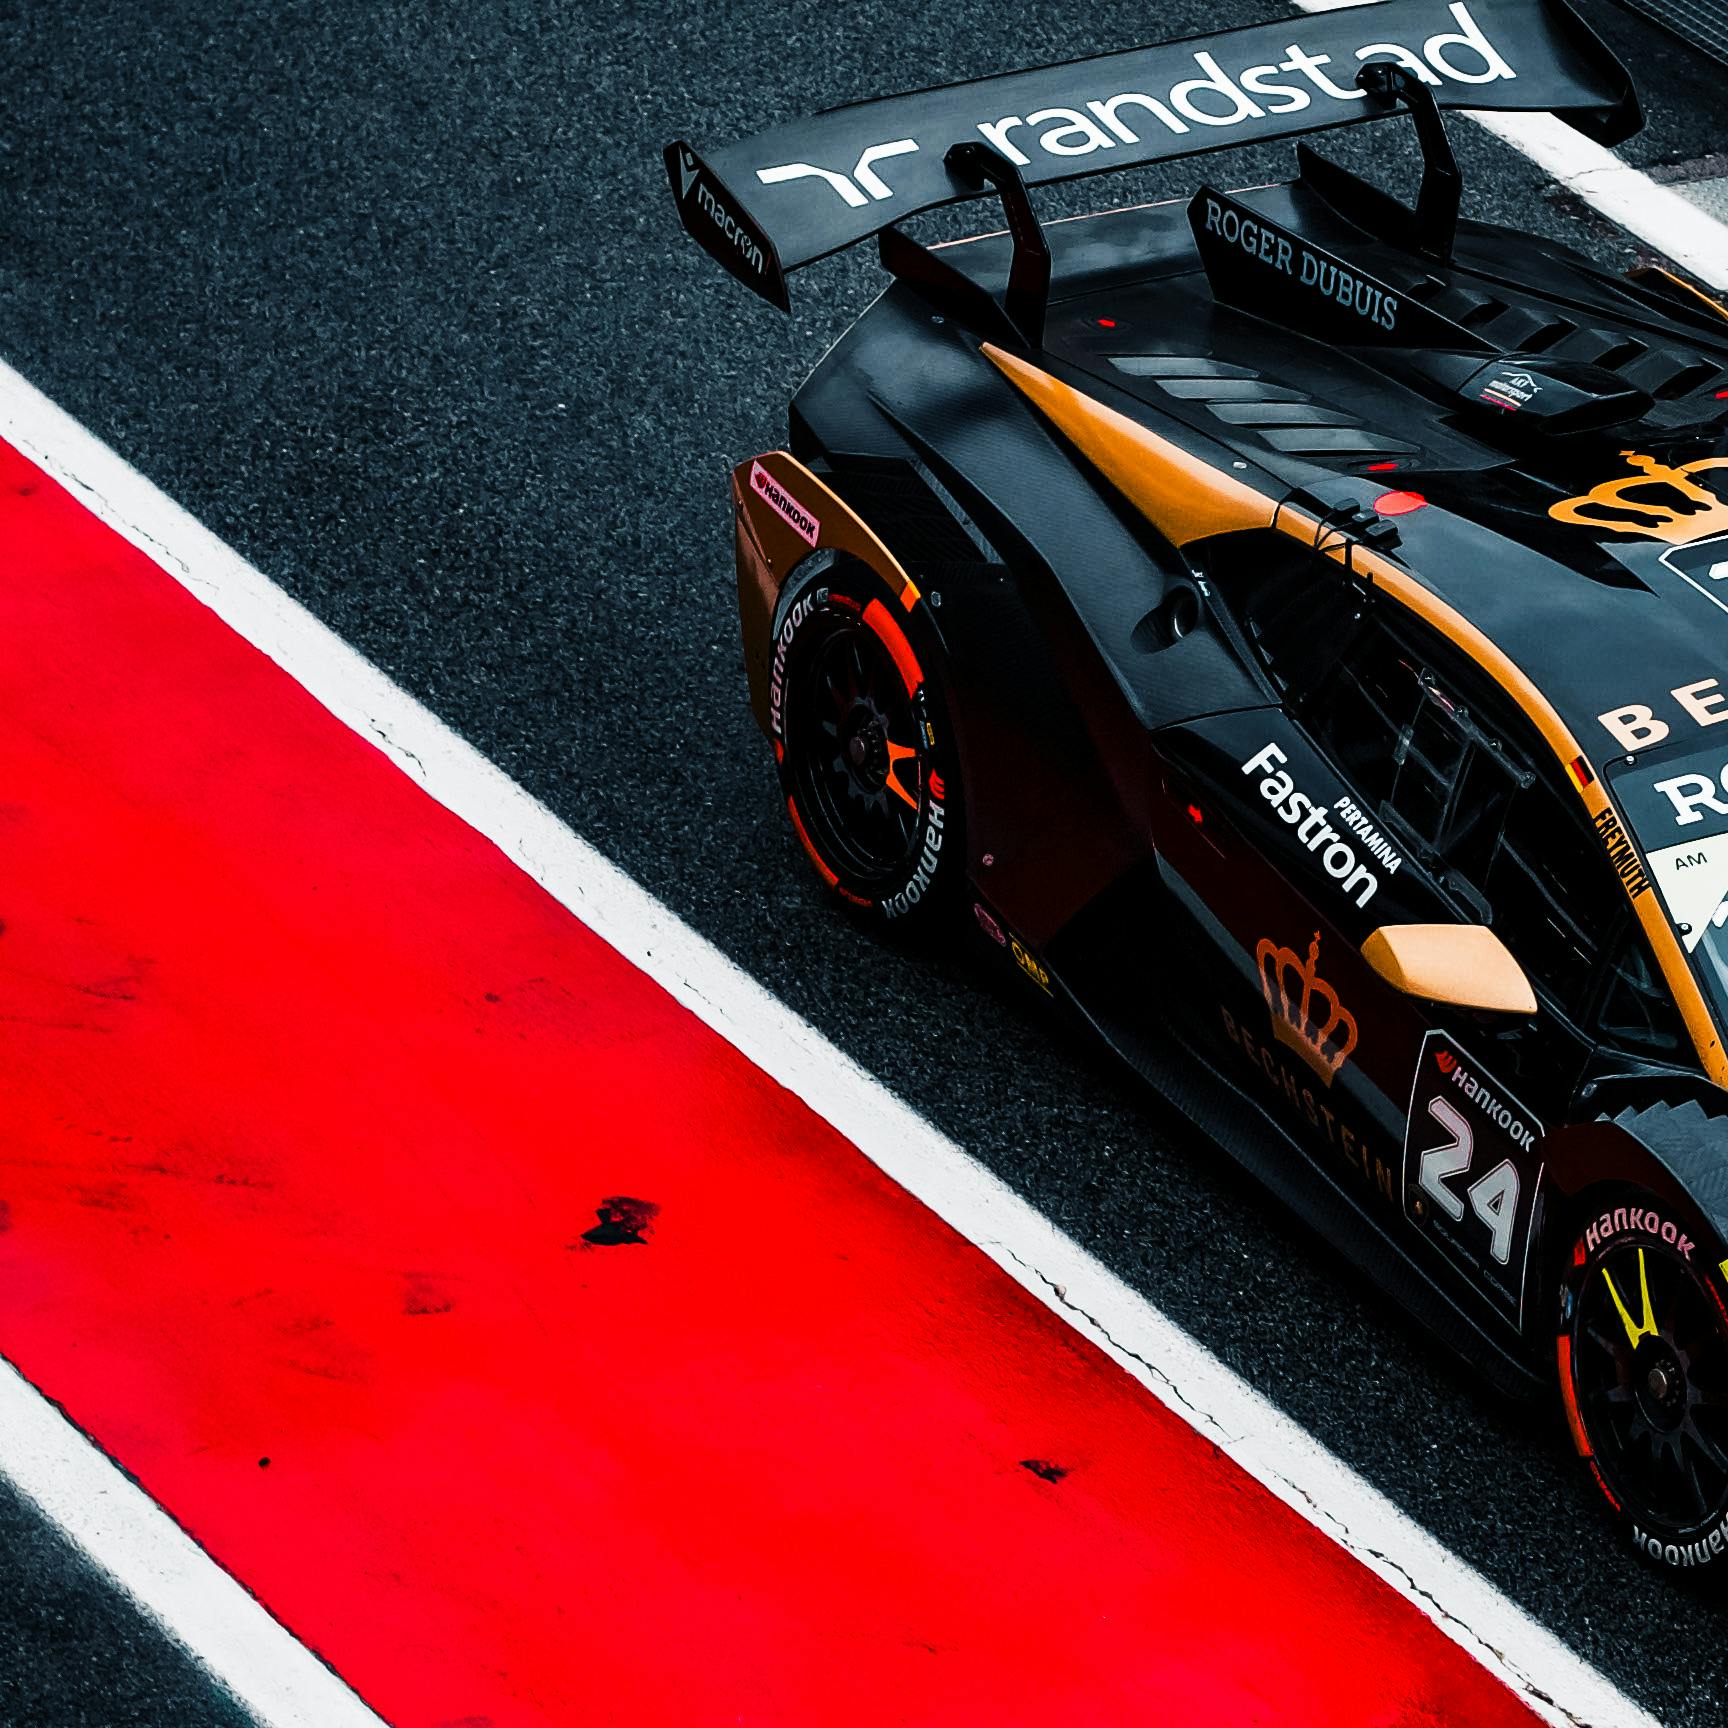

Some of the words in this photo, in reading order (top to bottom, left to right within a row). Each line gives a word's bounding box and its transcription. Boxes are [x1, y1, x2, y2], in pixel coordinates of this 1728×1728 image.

[976, 1, 1517, 167] randstad
[697, 183, 765, 274] macron
[1205, 198, 1293, 275] ROGER
[1299, 250, 1398, 331] DUBUIS
[1241, 742, 1379, 909] Fastron
[1333, 796, 1402, 875] PERTAMINA
[1593, 806, 1650, 900] FREYMUTH
[1675, 851, 1709, 871] AM
[1220, 1003, 1394, 1202] BECHSTEIN
[1418, 1094, 1521, 1265] 24
